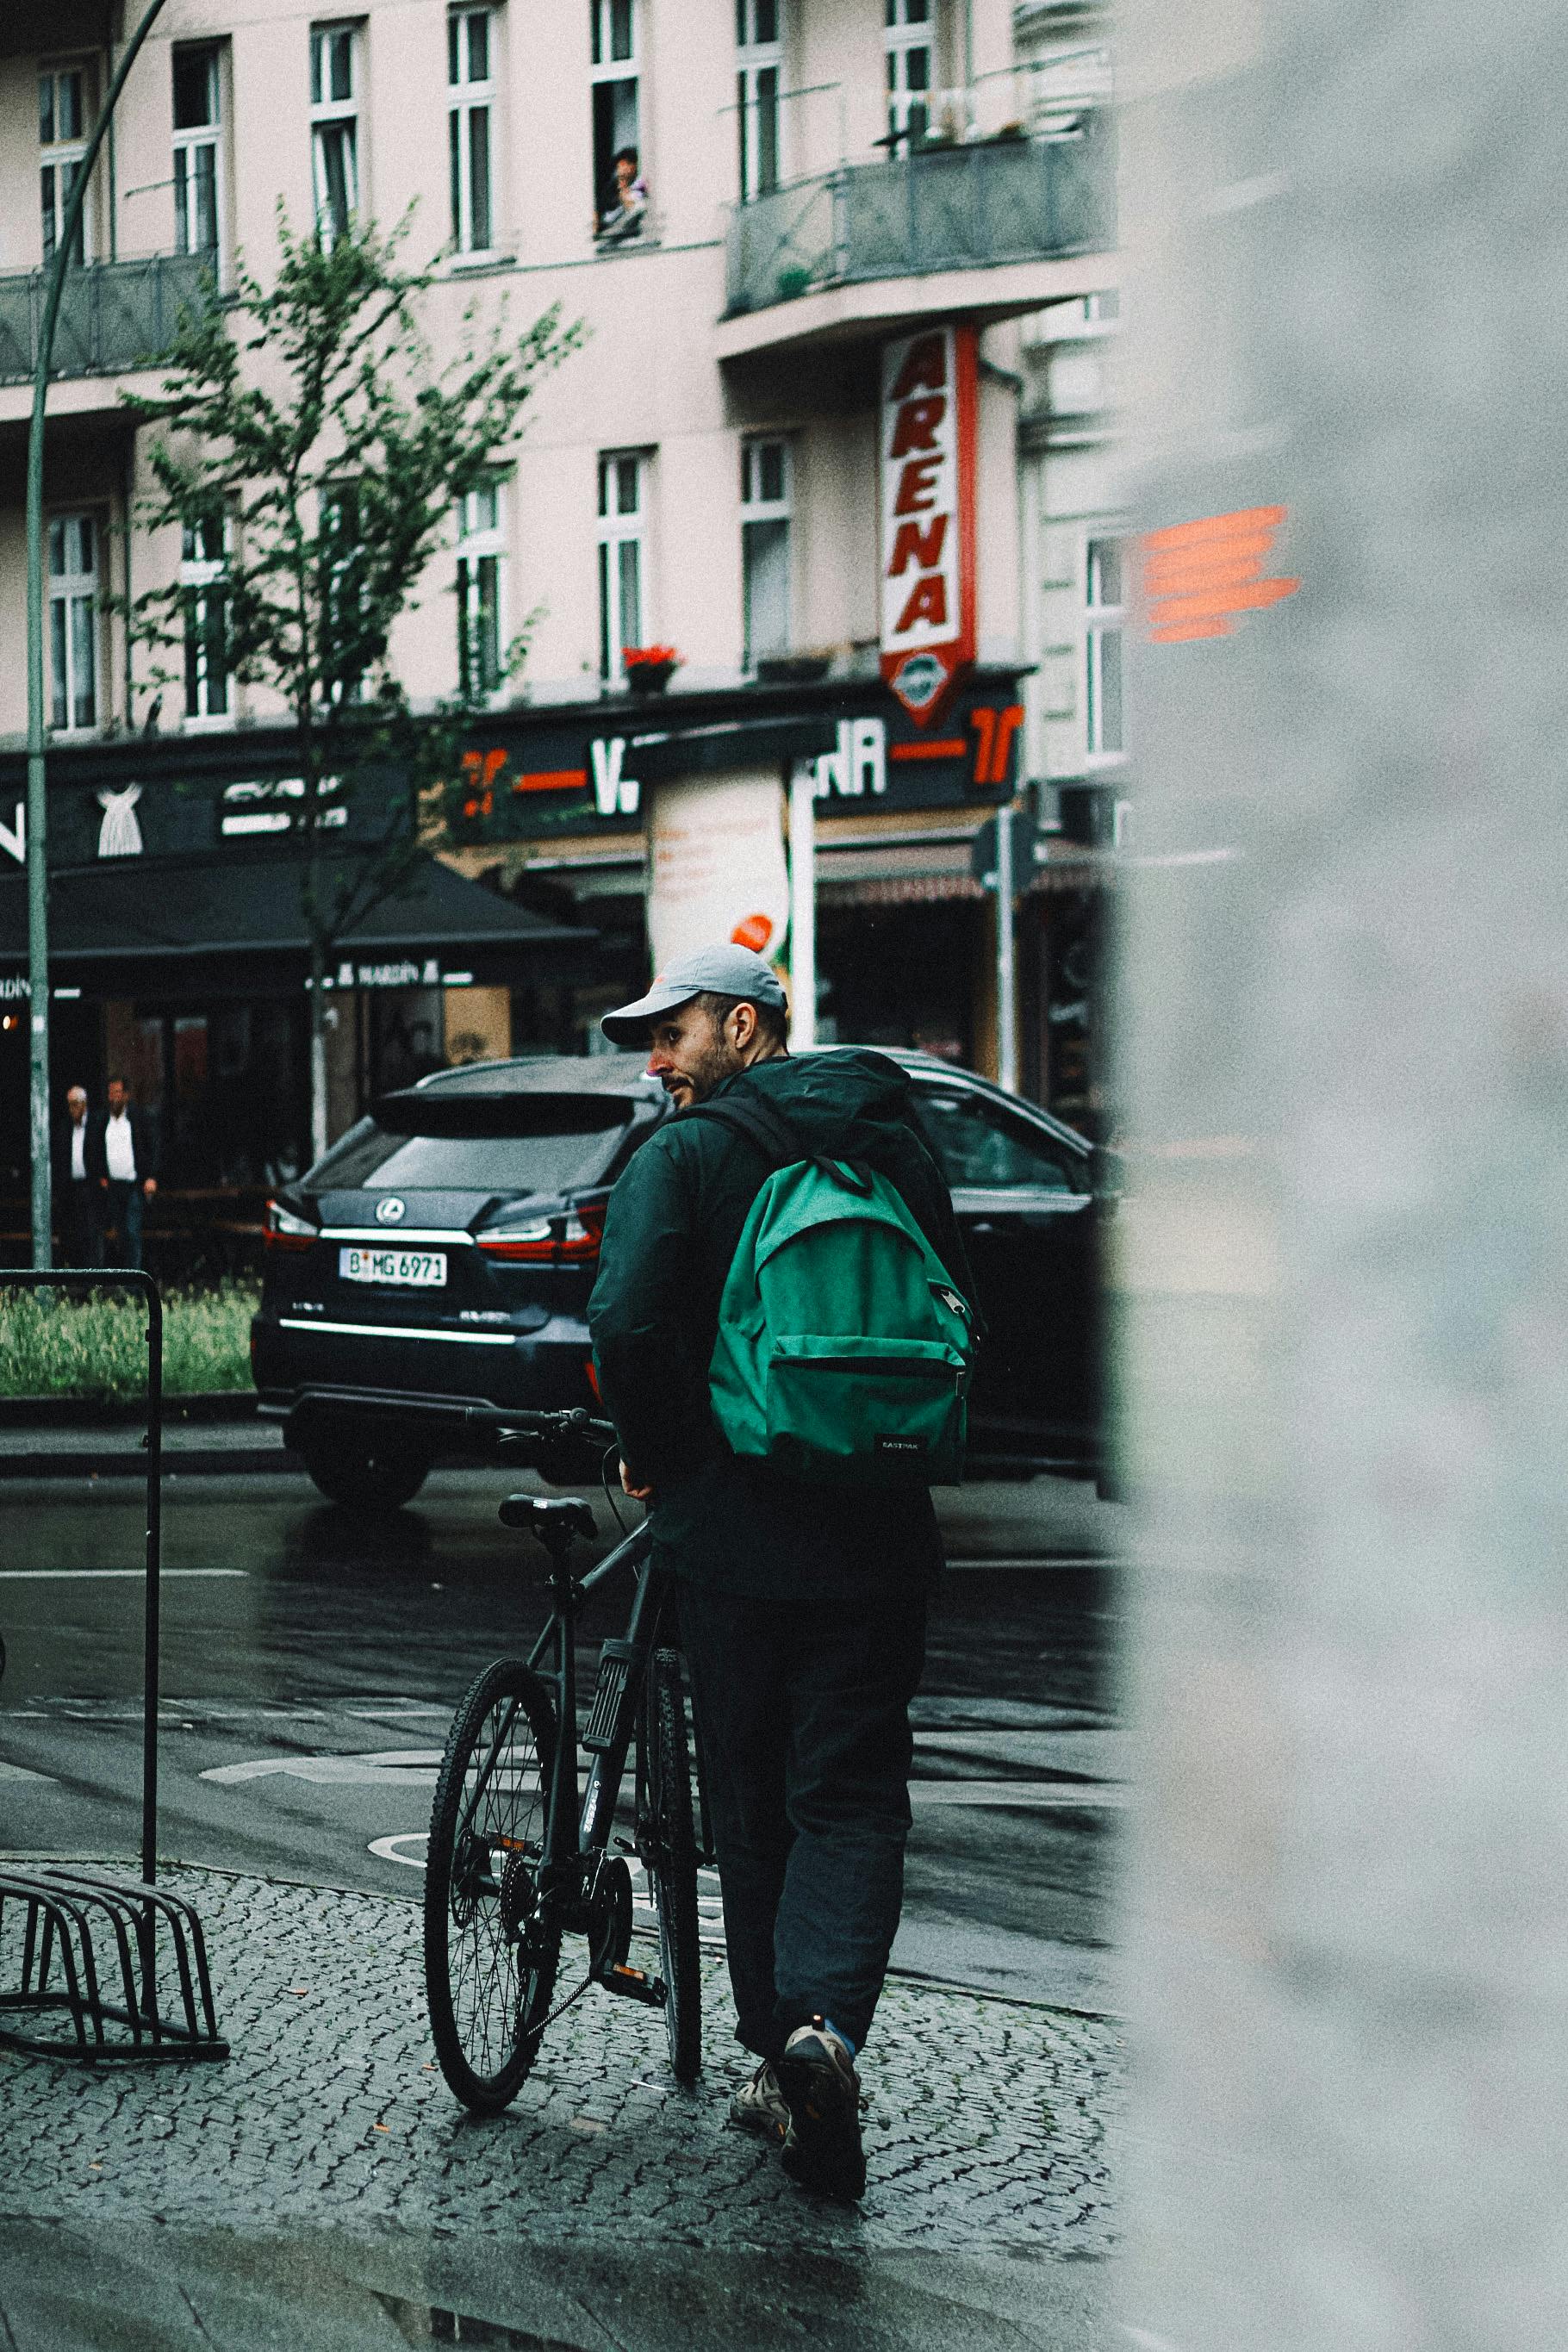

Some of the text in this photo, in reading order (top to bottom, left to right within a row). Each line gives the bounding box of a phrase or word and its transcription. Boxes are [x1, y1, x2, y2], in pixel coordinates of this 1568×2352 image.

[890, 330, 949, 634] ARENA
[373, 1254, 395, 1276] MG
[400, 1255, 442, 1280] 6971
[882, 1441, 919, 1450] EASTPAK
